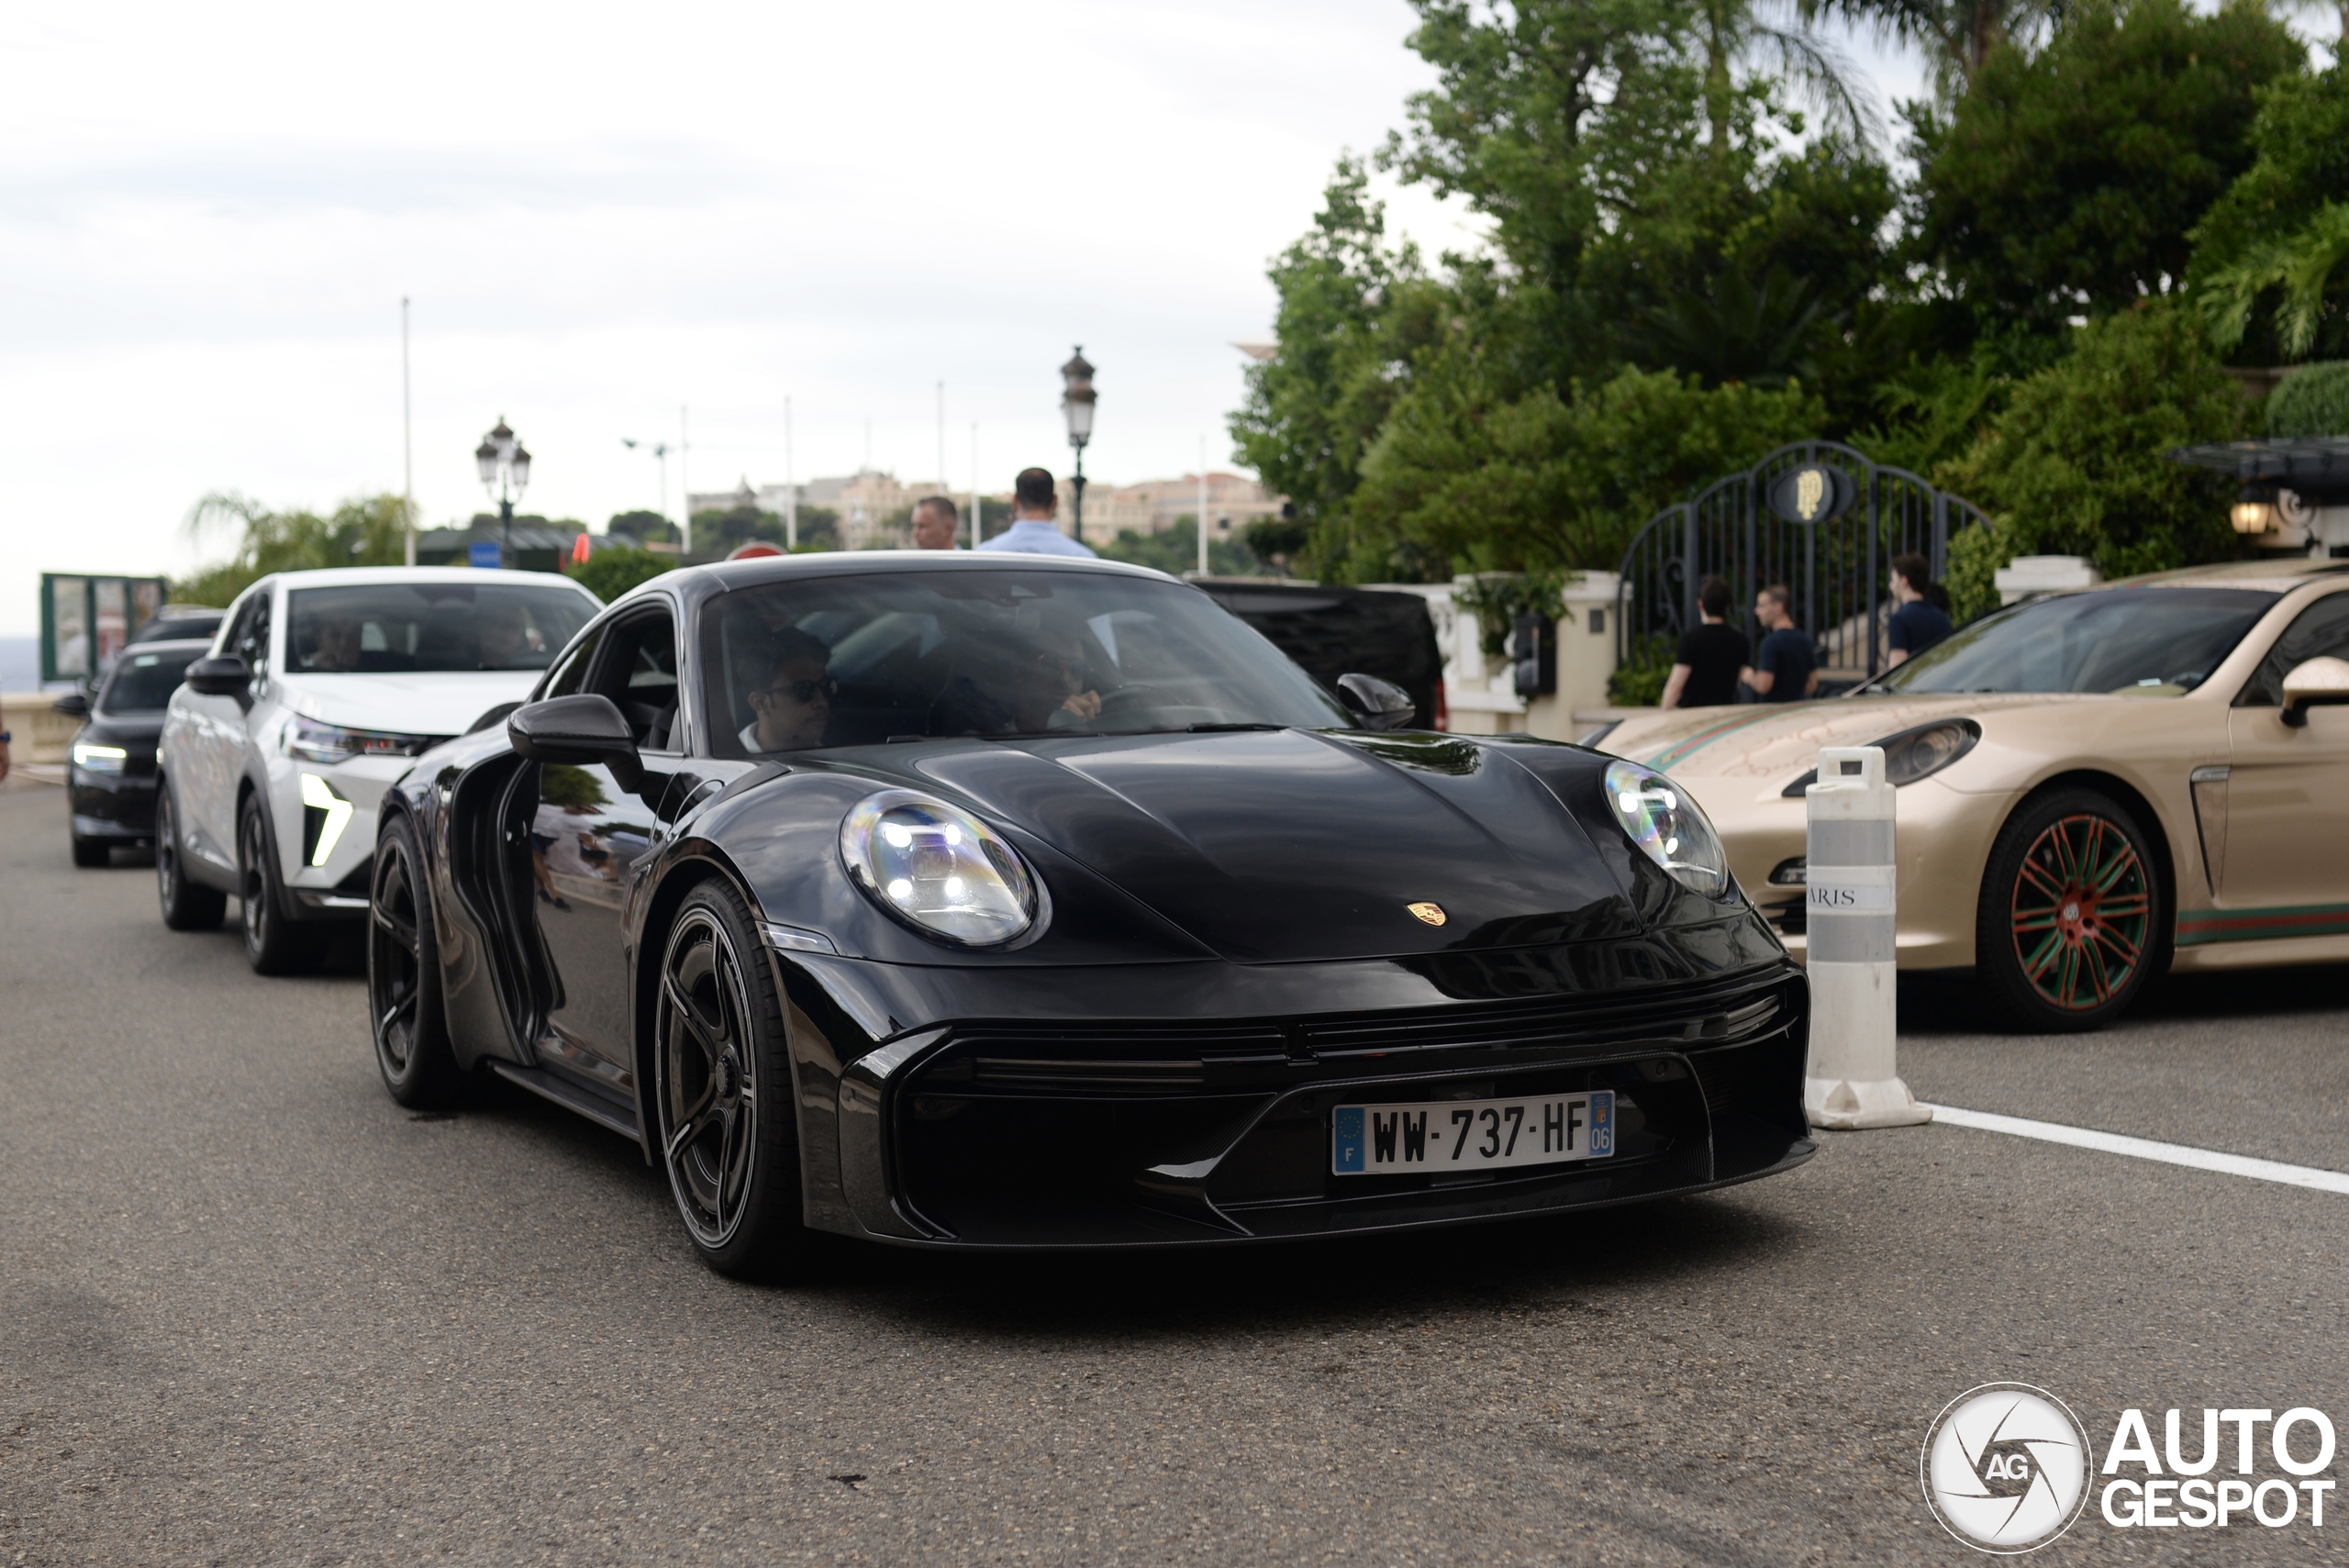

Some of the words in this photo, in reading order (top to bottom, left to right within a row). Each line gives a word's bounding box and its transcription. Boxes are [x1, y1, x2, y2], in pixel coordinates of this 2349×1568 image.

[1808, 887, 1854, 907] ARIS
[1373, 1101, 1586, 1163] WW-737-HF
[1591, 1128, 1609, 1151] 06
[1345, 1148, 1354, 1162] F
